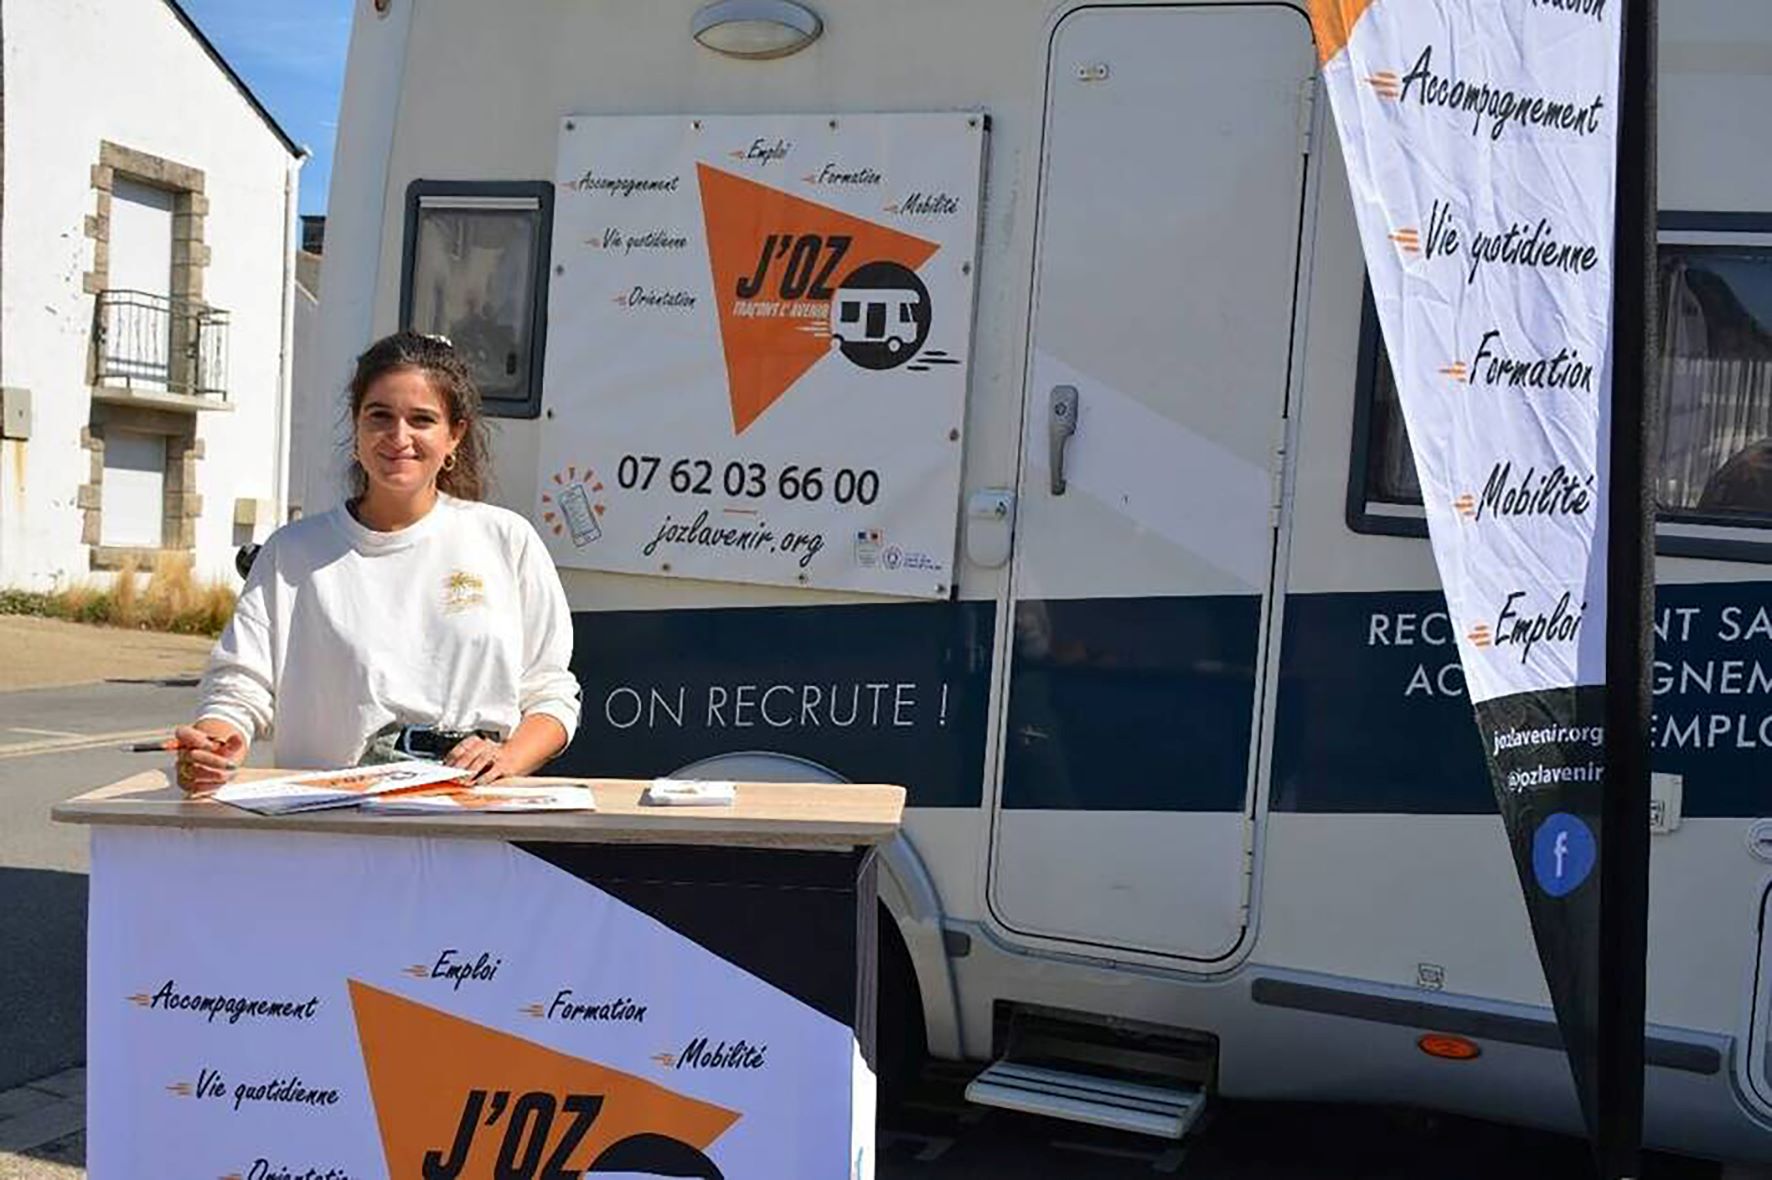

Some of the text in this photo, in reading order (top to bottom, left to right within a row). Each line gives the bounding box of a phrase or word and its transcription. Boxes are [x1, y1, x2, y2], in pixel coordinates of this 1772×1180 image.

[1400, 45, 1604, 141] Accompagnement
[747, 138, 791, 167] Emploi
[578, 170, 680, 197] Accompagnement
[817, 164, 882, 185] Formation
[900, 193, 960, 215] Mobilité
[624, 230, 688, 256] quotidienne
[1425, 199, 1599, 285] Vie quotidienne
[628, 285, 697, 310] Orientation
[1469, 330, 1593, 393] Formation
[617, 455, 880, 506] 07 62 03 66 00
[1475, 462, 1594, 522] Mobilité
[643, 510, 825, 568] jozlavenir.org
[1494, 591, 1587, 664] Emploi
[605, 687, 685, 729] ON
[706, 684, 916, 727] RECRUTE
[937, 683, 948, 726] !
[1493, 723, 1603, 757] jozlavenir.org
[1507, 761, 1605, 793] @jozlavenir
[431, 949, 502, 991] Emploi
[151, 980, 319, 1024] Accompagnement
[547, 990, 648, 1023] Formation
[676, 1037, 767, 1070] Mobilité
[196, 1069, 340, 1111] Vie quotidienne
